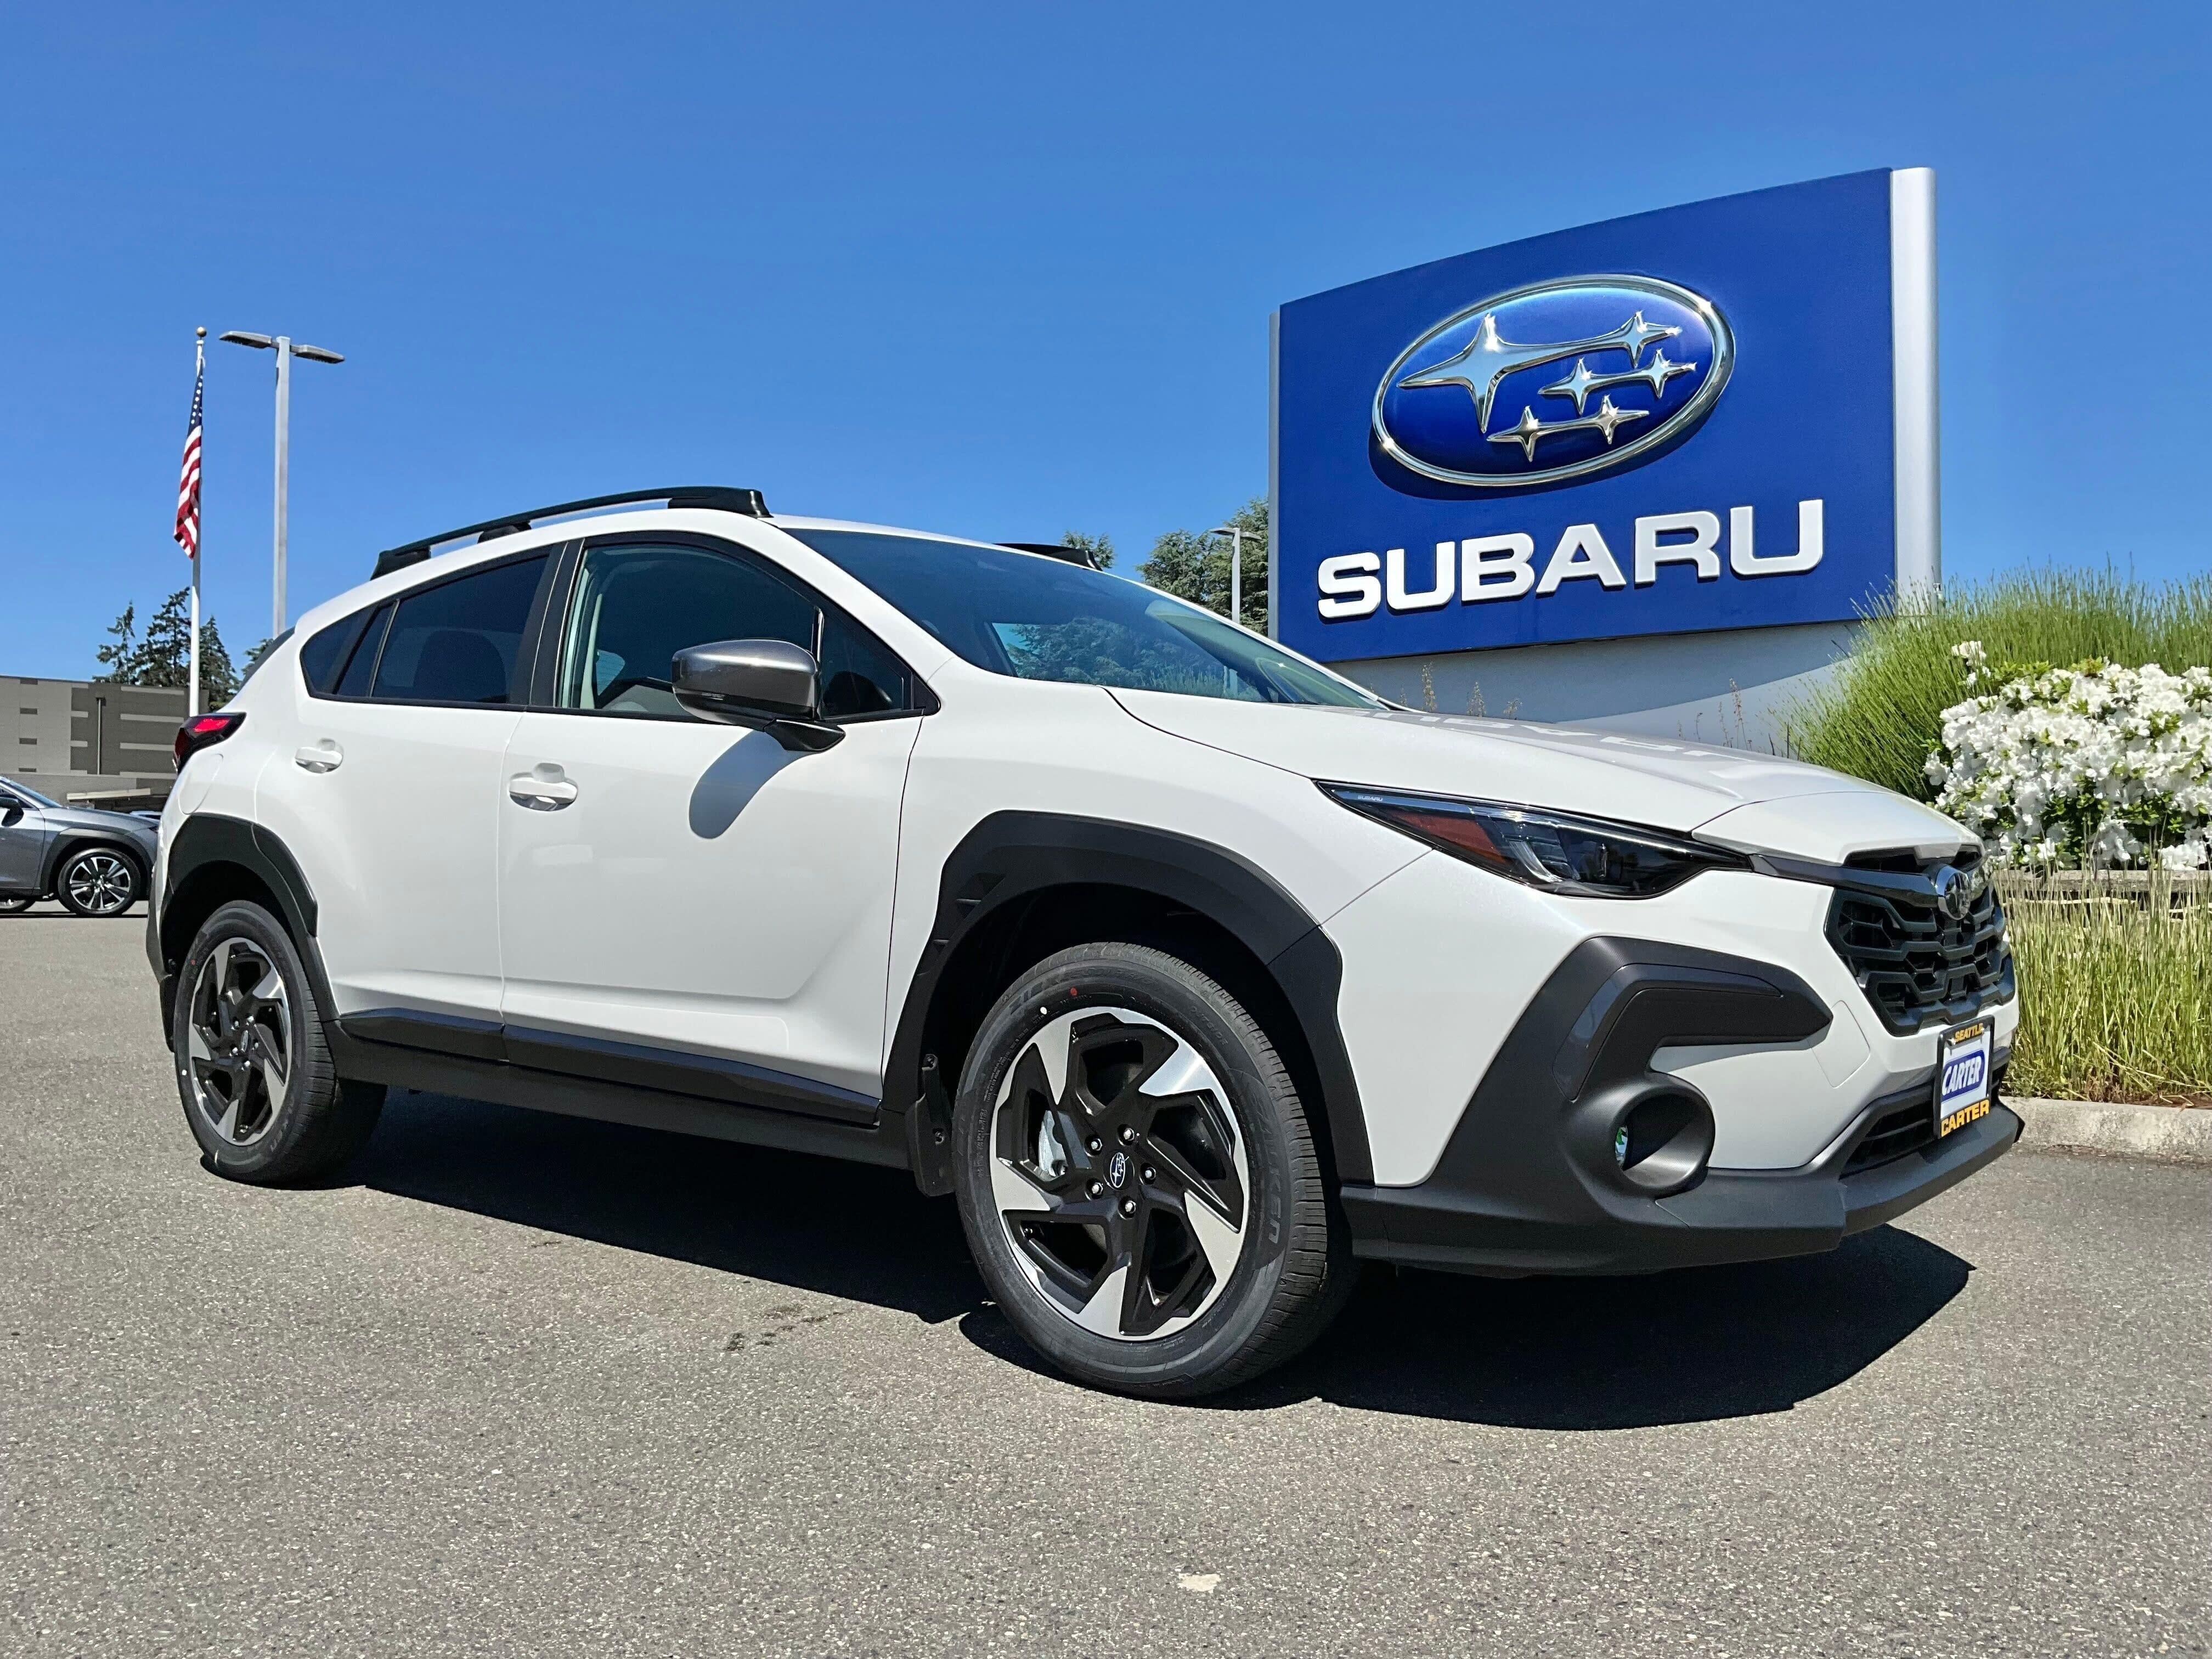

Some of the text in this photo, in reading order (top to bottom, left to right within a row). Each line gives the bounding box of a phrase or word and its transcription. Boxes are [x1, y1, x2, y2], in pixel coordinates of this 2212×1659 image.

[1317, 498, 1824, 620] SUBARU
[1955, 1023, 1984, 1042] SEATTLE
[1942, 1055, 1982, 1096] CARTER
[1940, 1099, 1990, 1137] CARTER
